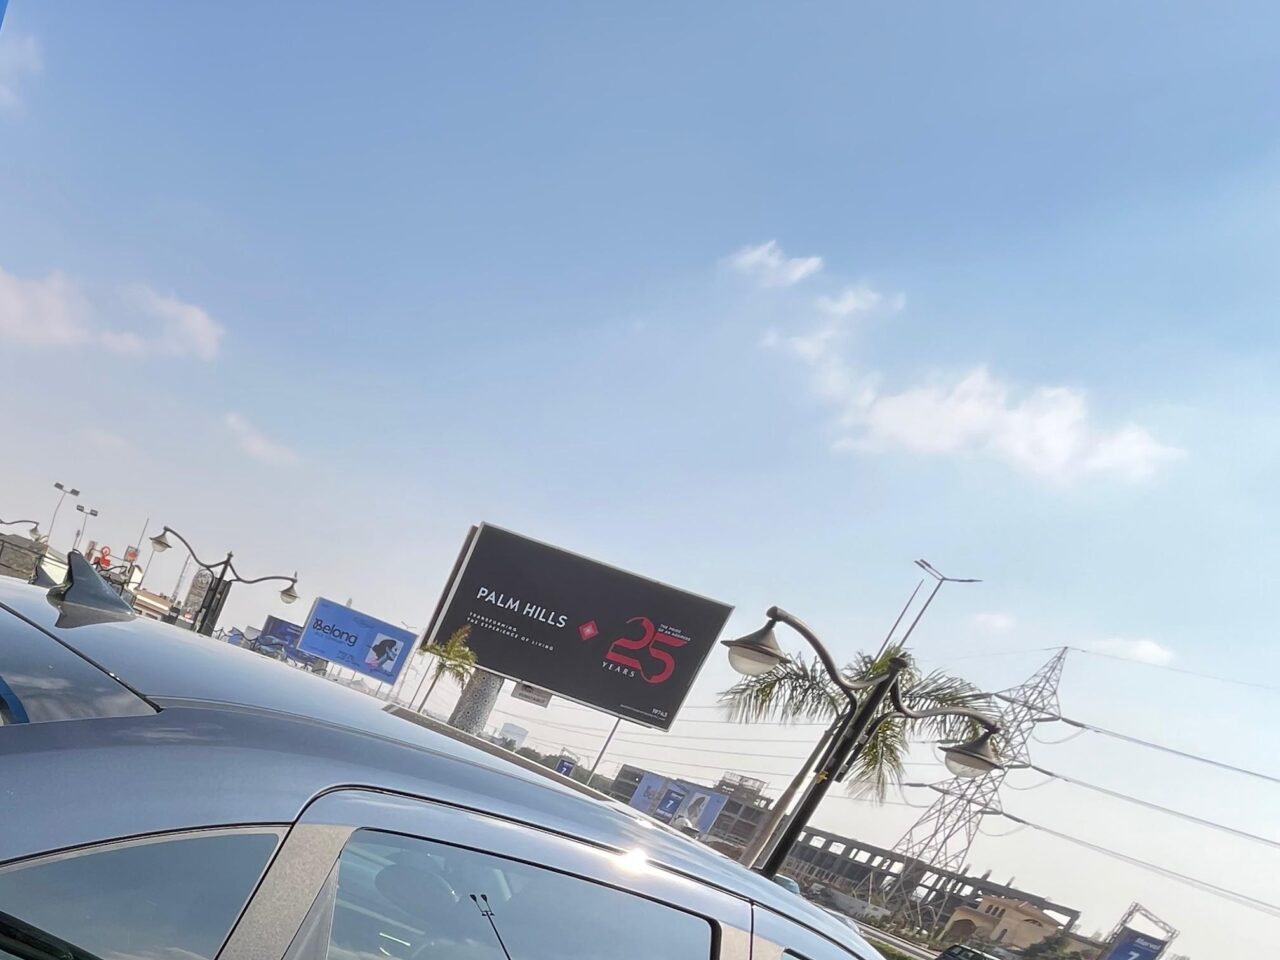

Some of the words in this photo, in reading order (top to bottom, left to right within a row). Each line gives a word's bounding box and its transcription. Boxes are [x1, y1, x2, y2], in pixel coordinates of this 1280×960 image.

[469, 611, 517, 632] TRANSFORMING
[476, 587, 520, 613] PALM
[522, 602, 568, 629] HILLS
[312, 617, 359, 648] Belong
[466, 616, 479, 625] THE
[480, 621, 519, 639] EXPERIENCE
[520, 635, 530, 643] OF
[531, 640, 554, 651] LIVING
[606, 616, 688, 684] 25
[601, 660, 636, 678] YEARS
